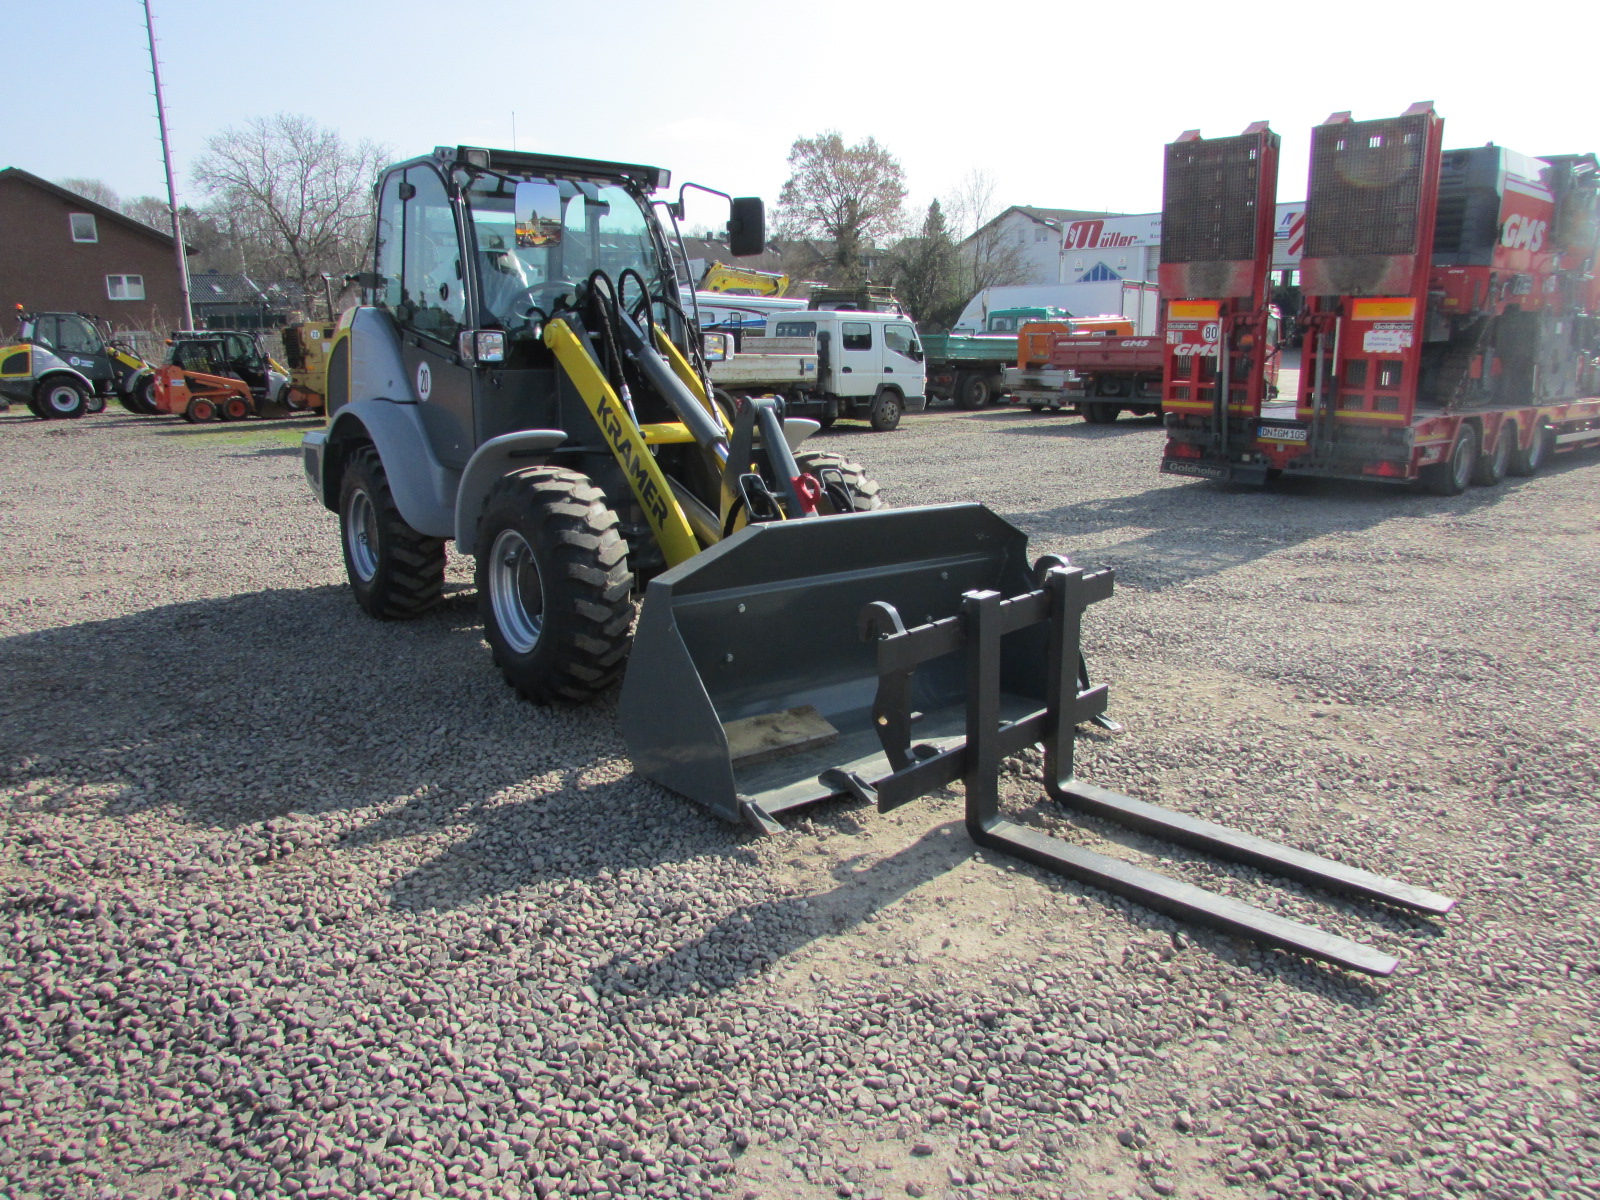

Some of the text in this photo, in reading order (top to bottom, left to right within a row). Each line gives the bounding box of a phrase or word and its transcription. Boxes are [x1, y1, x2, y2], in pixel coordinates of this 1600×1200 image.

[1501, 213, 1547, 252] GMS
[1205, 326, 1218, 339] 80
[420, 369, 429, 393] 20
[1262, 426, 1273, 437] DN
[1289, 429, 1306, 440] 105
[597, 394, 669, 531] KRAMER
